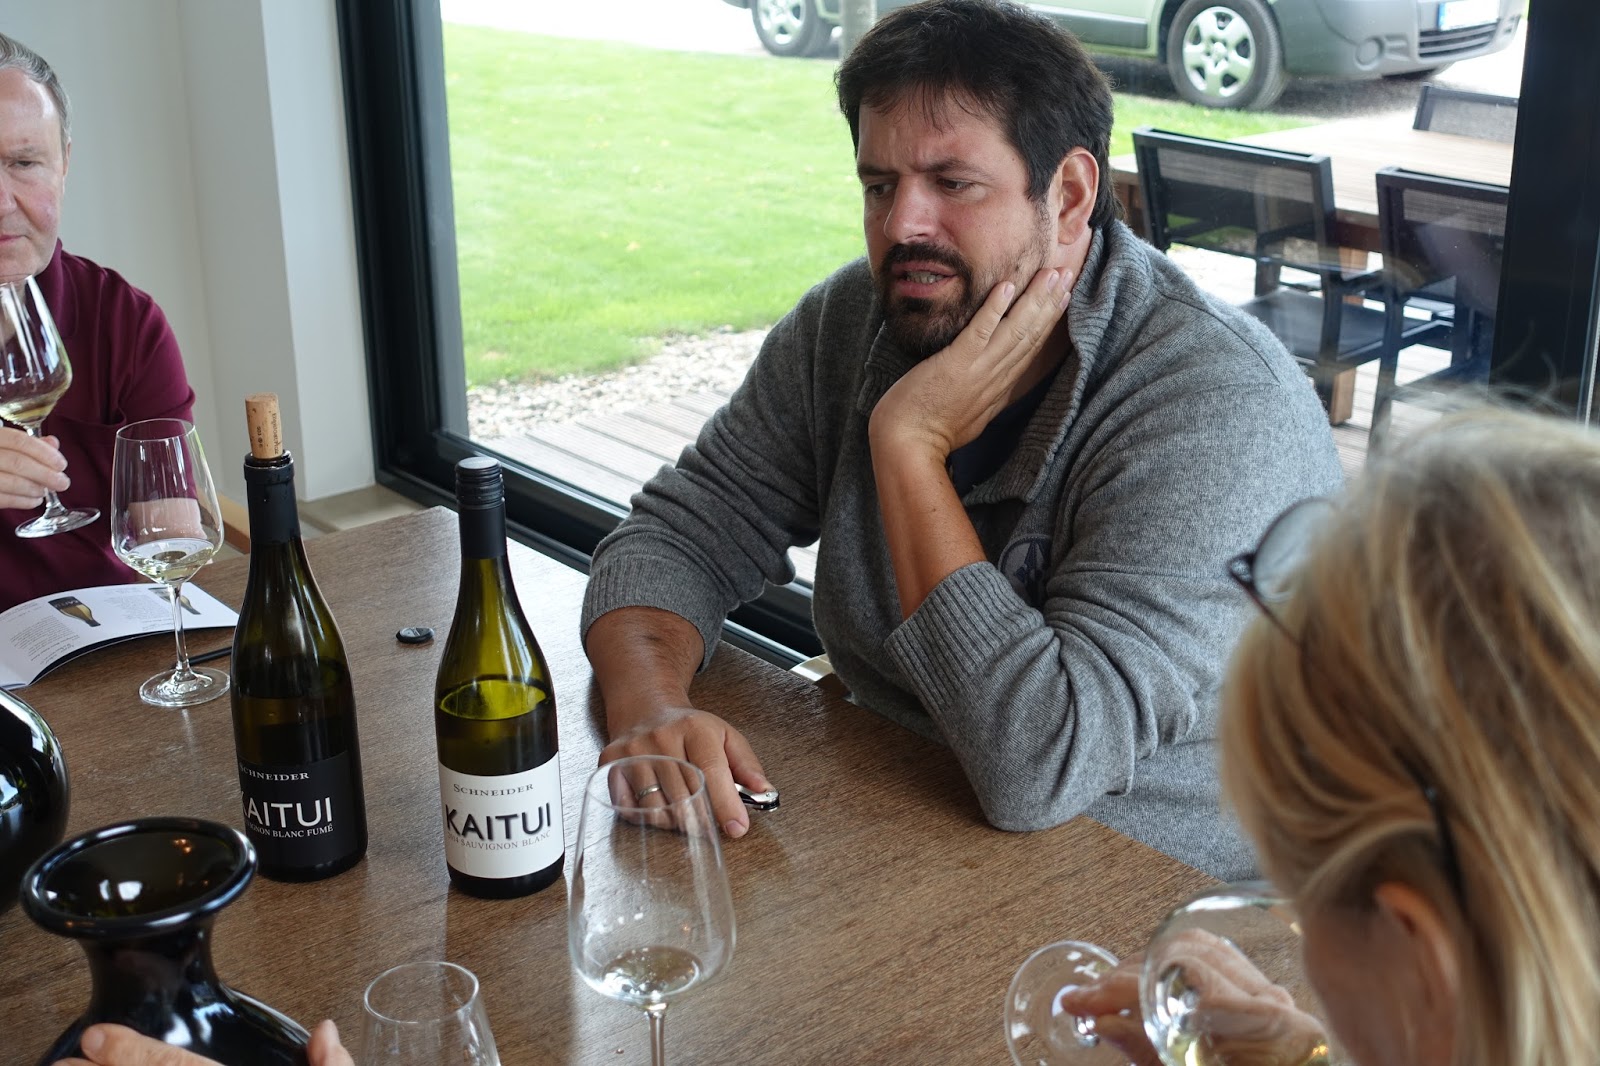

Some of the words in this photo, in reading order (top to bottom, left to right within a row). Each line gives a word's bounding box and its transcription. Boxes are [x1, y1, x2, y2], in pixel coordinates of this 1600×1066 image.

[453, 783, 534, 797] SCHNEIDER
[272, 829, 305, 838] BLANC
[306, 823, 334, 837] FUMÉ
[445, 802, 551, 841] KAITUI
[460, 839, 519, 851] SAUVIGNON
[521, 829, 551, 847] BLANC
